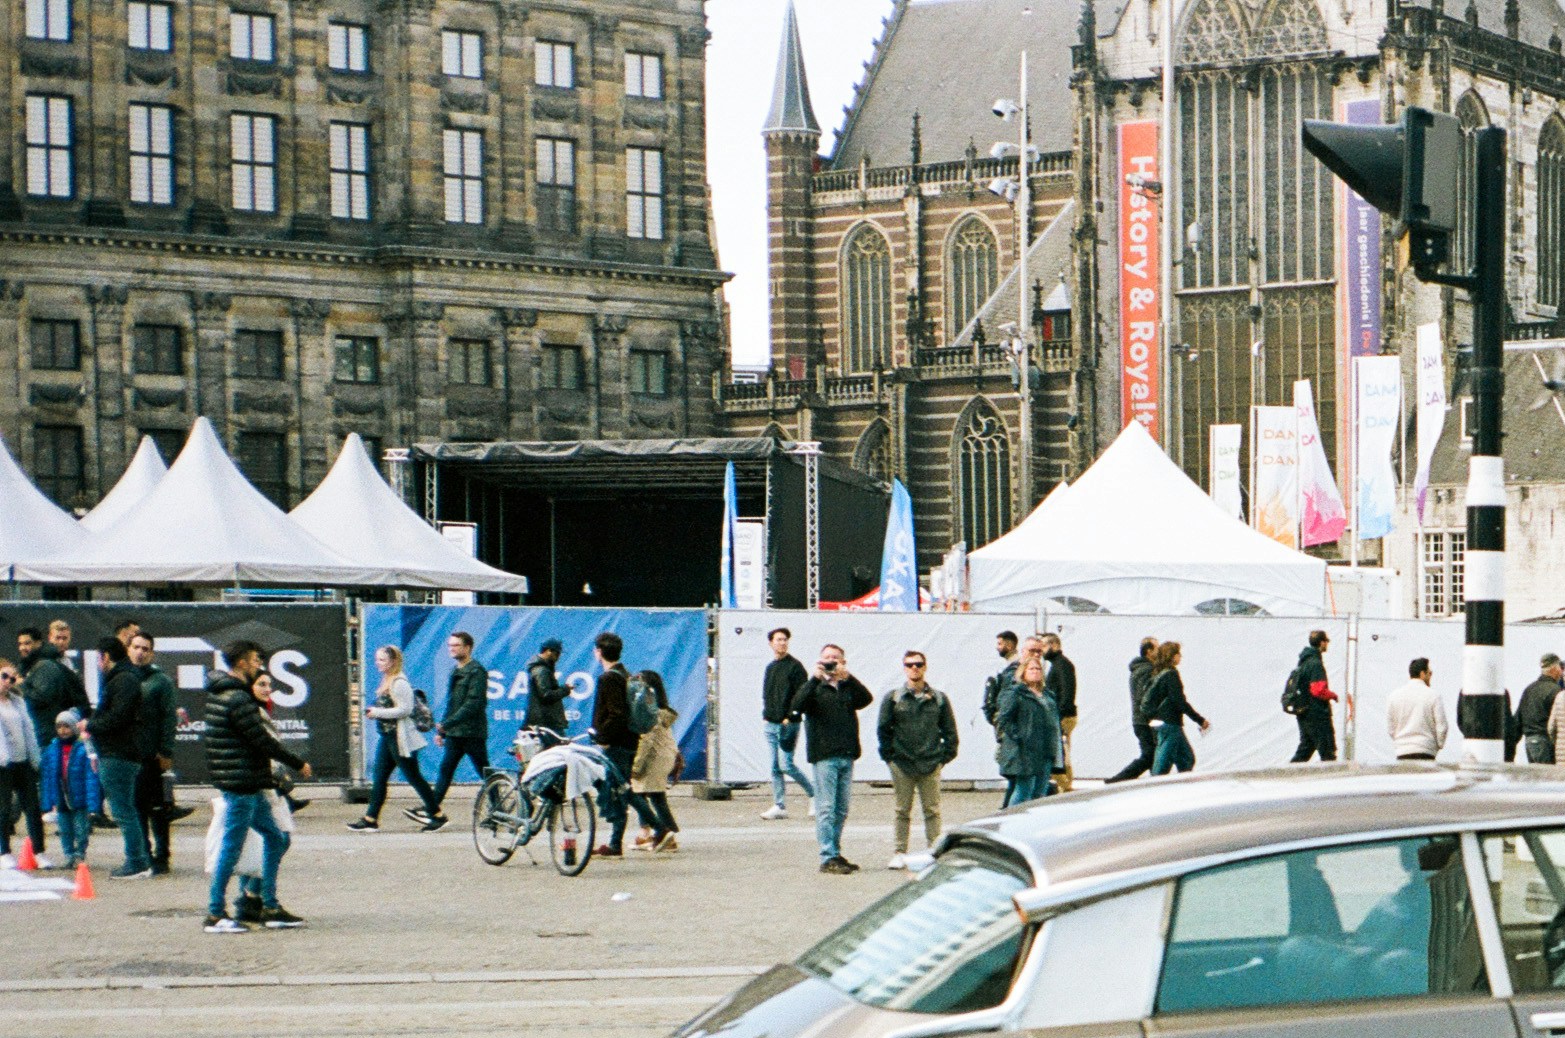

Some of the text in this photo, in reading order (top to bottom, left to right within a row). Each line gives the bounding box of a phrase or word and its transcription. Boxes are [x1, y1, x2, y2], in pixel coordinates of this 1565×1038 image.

[1129, 287, 1155, 311] &
[1125, 321, 1157, 432] Royalt
[486, 669, 595, 701] SAO
